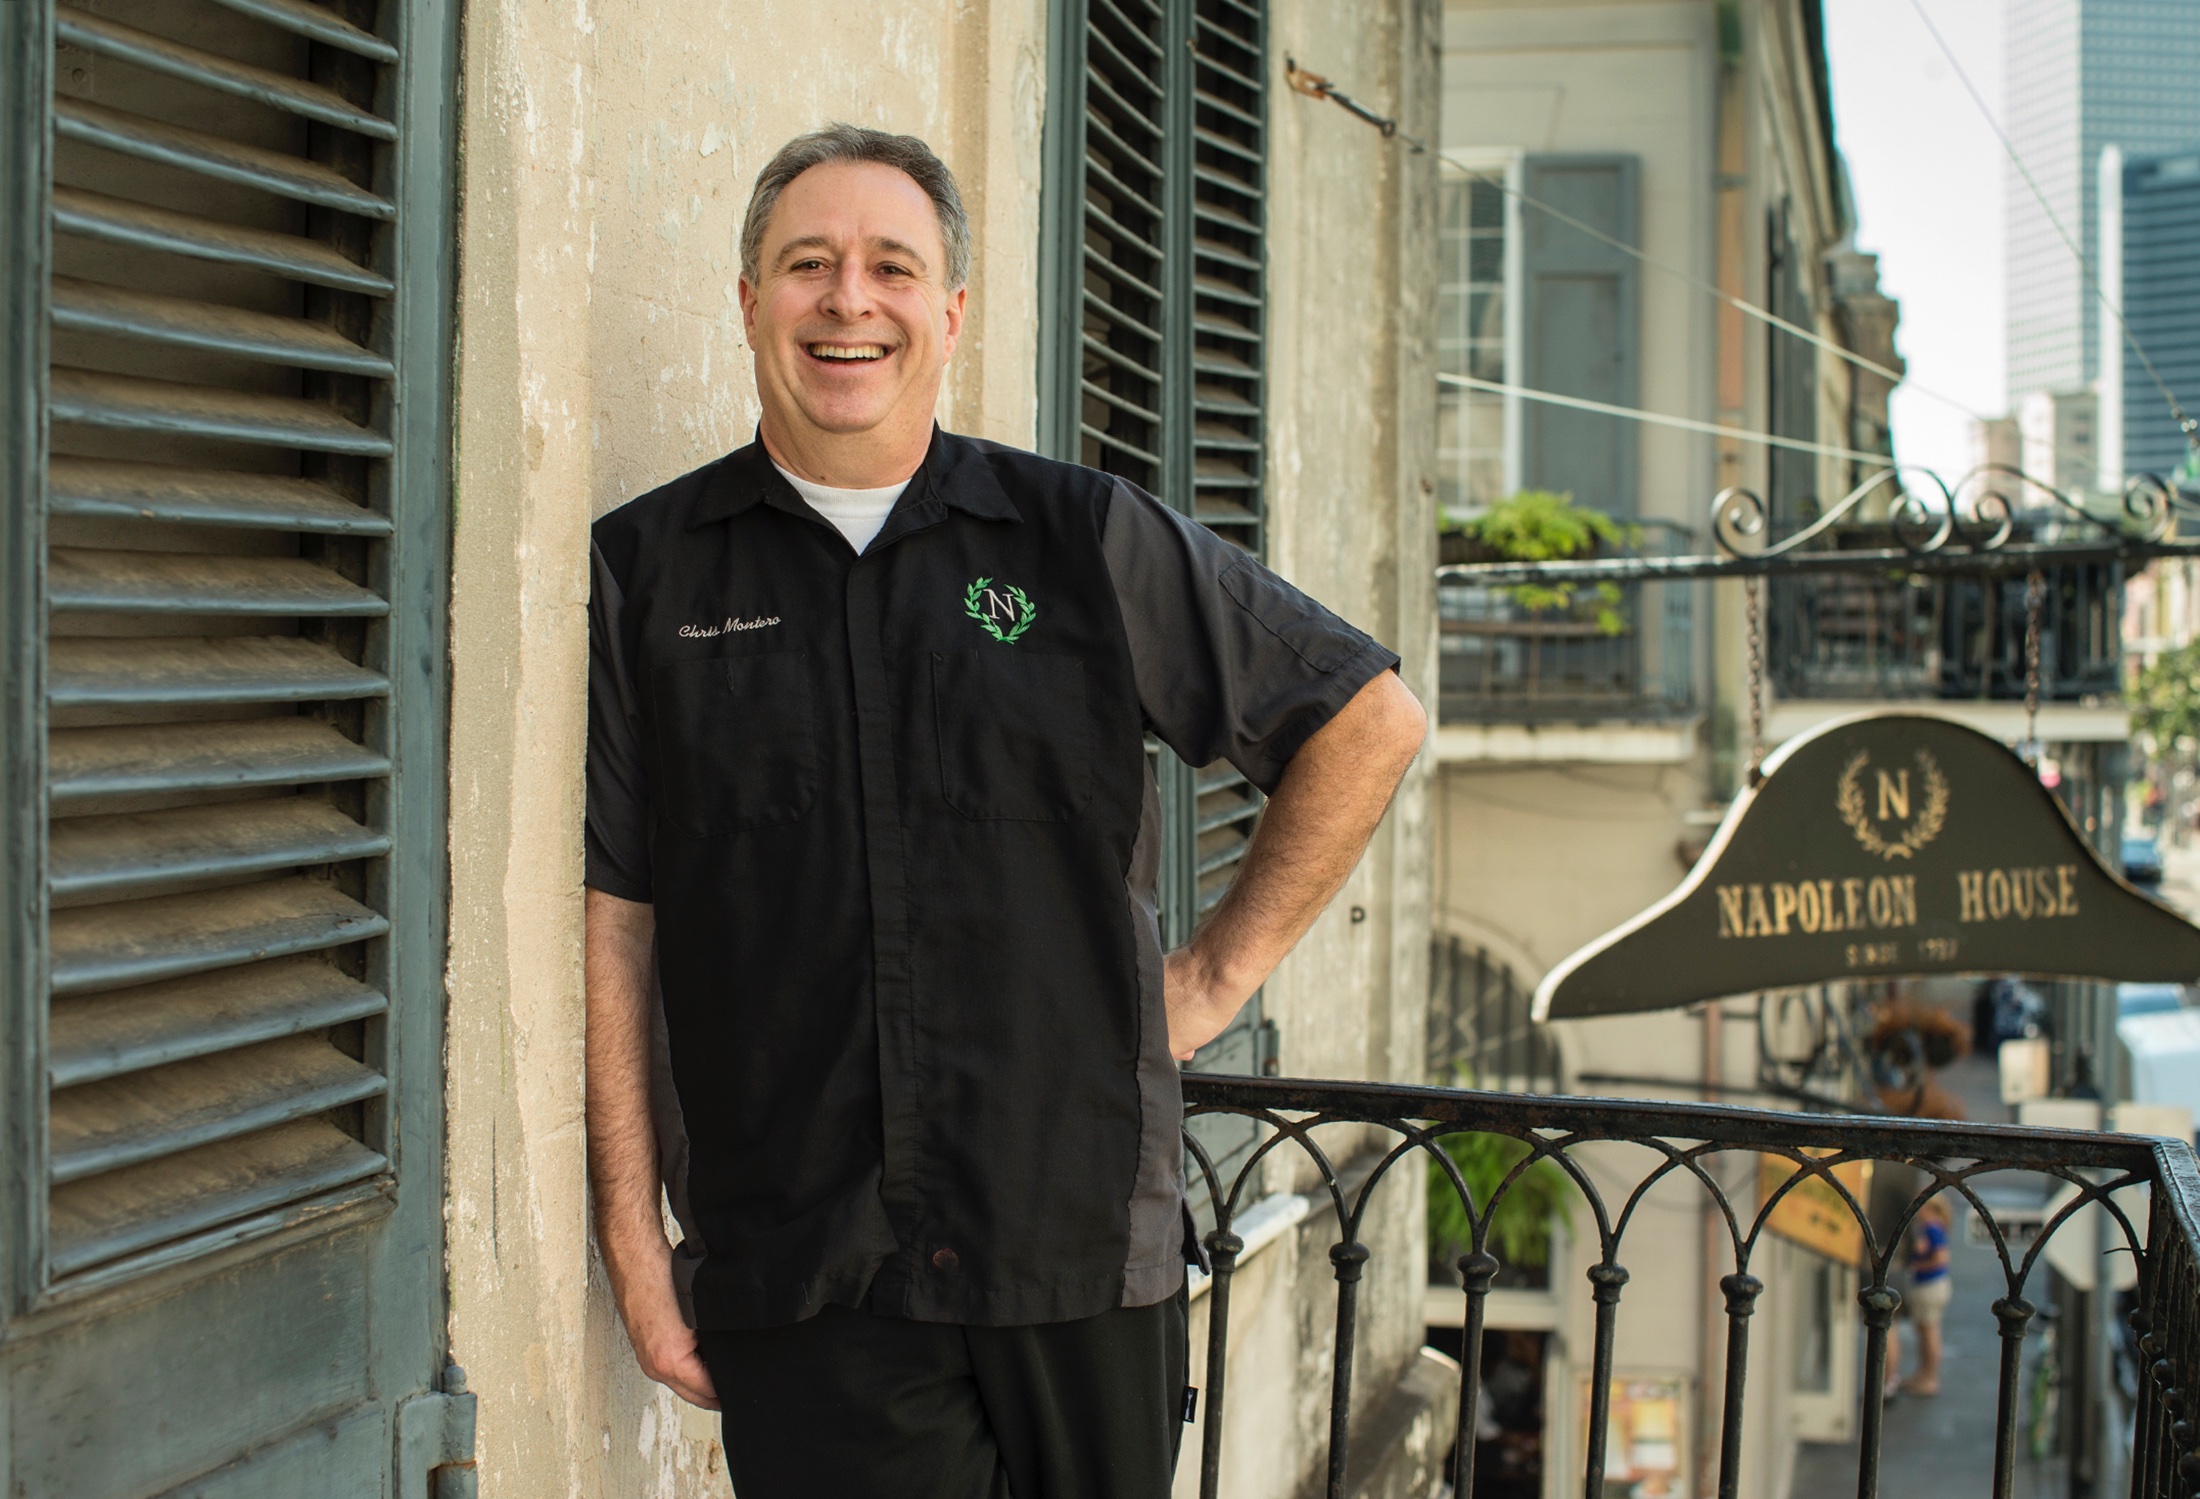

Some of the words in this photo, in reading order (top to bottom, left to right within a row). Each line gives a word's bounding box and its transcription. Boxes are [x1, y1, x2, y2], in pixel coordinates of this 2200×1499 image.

[678, 624, 721, 638] Chris
[722, 615, 782, 635] Montero
[983, 588, 1015, 622] N
[1877, 768, 1910, 820] N
[1715, 874, 1918, 939] NAPOLEON
[1957, 864, 2080, 923] HOUSE
